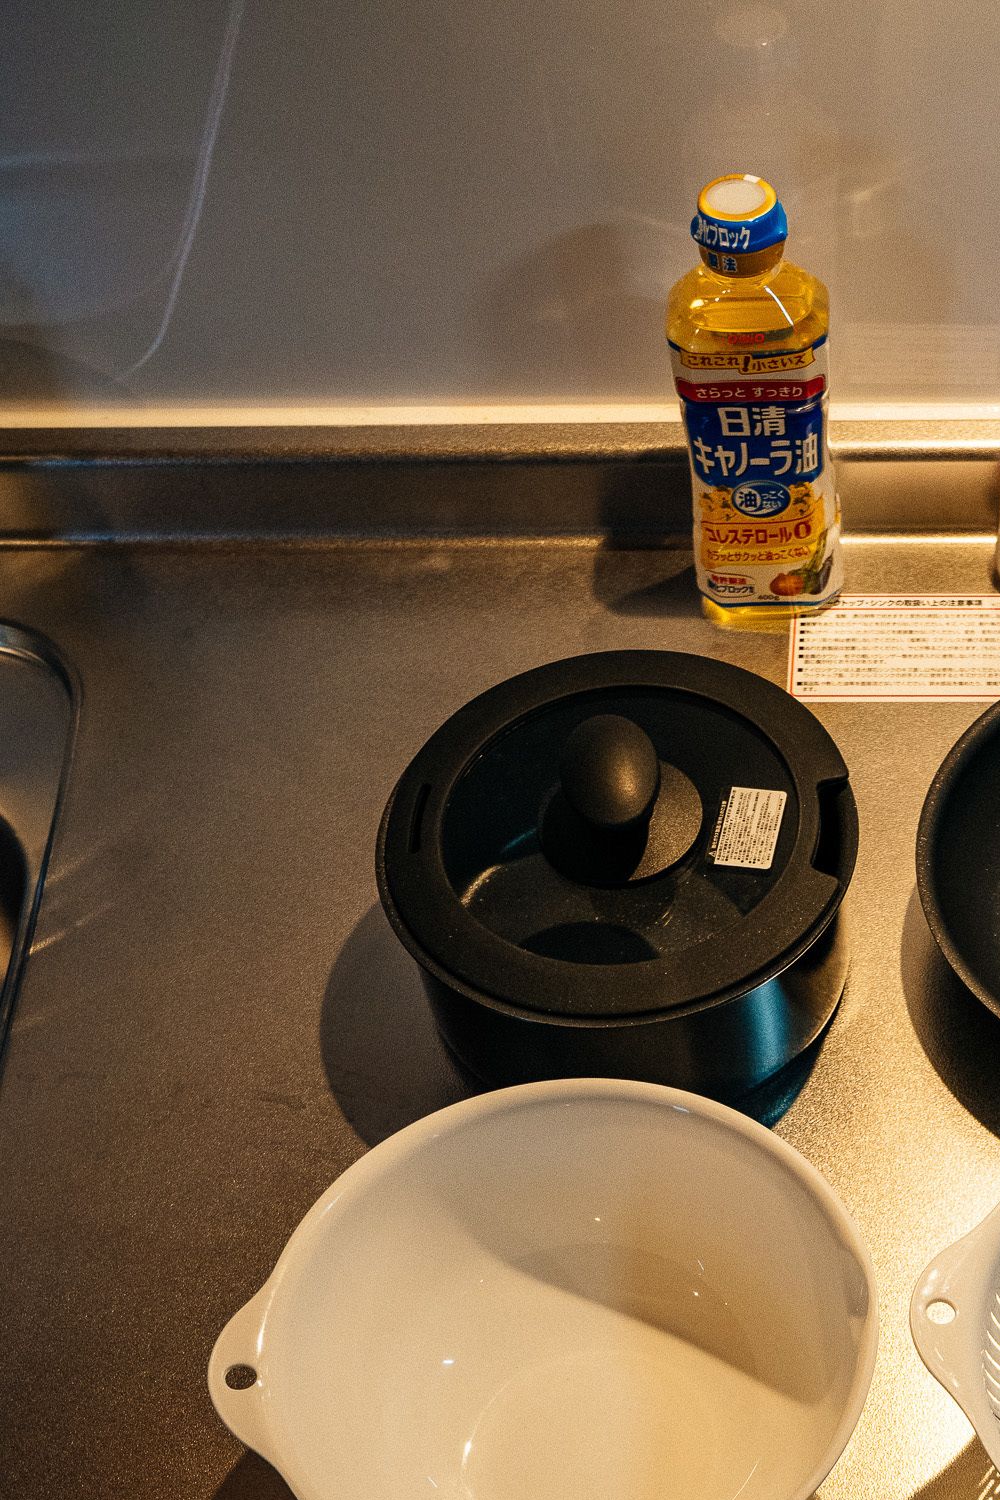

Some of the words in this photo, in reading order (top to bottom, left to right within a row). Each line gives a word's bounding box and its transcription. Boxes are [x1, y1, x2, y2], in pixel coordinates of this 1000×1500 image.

[696, 387, 746, 398] さらっと
[752, 386, 803, 397] すっきり
[717, 405, 786, 437] 日清
[693, 432, 818, 477] キャノーラ油
